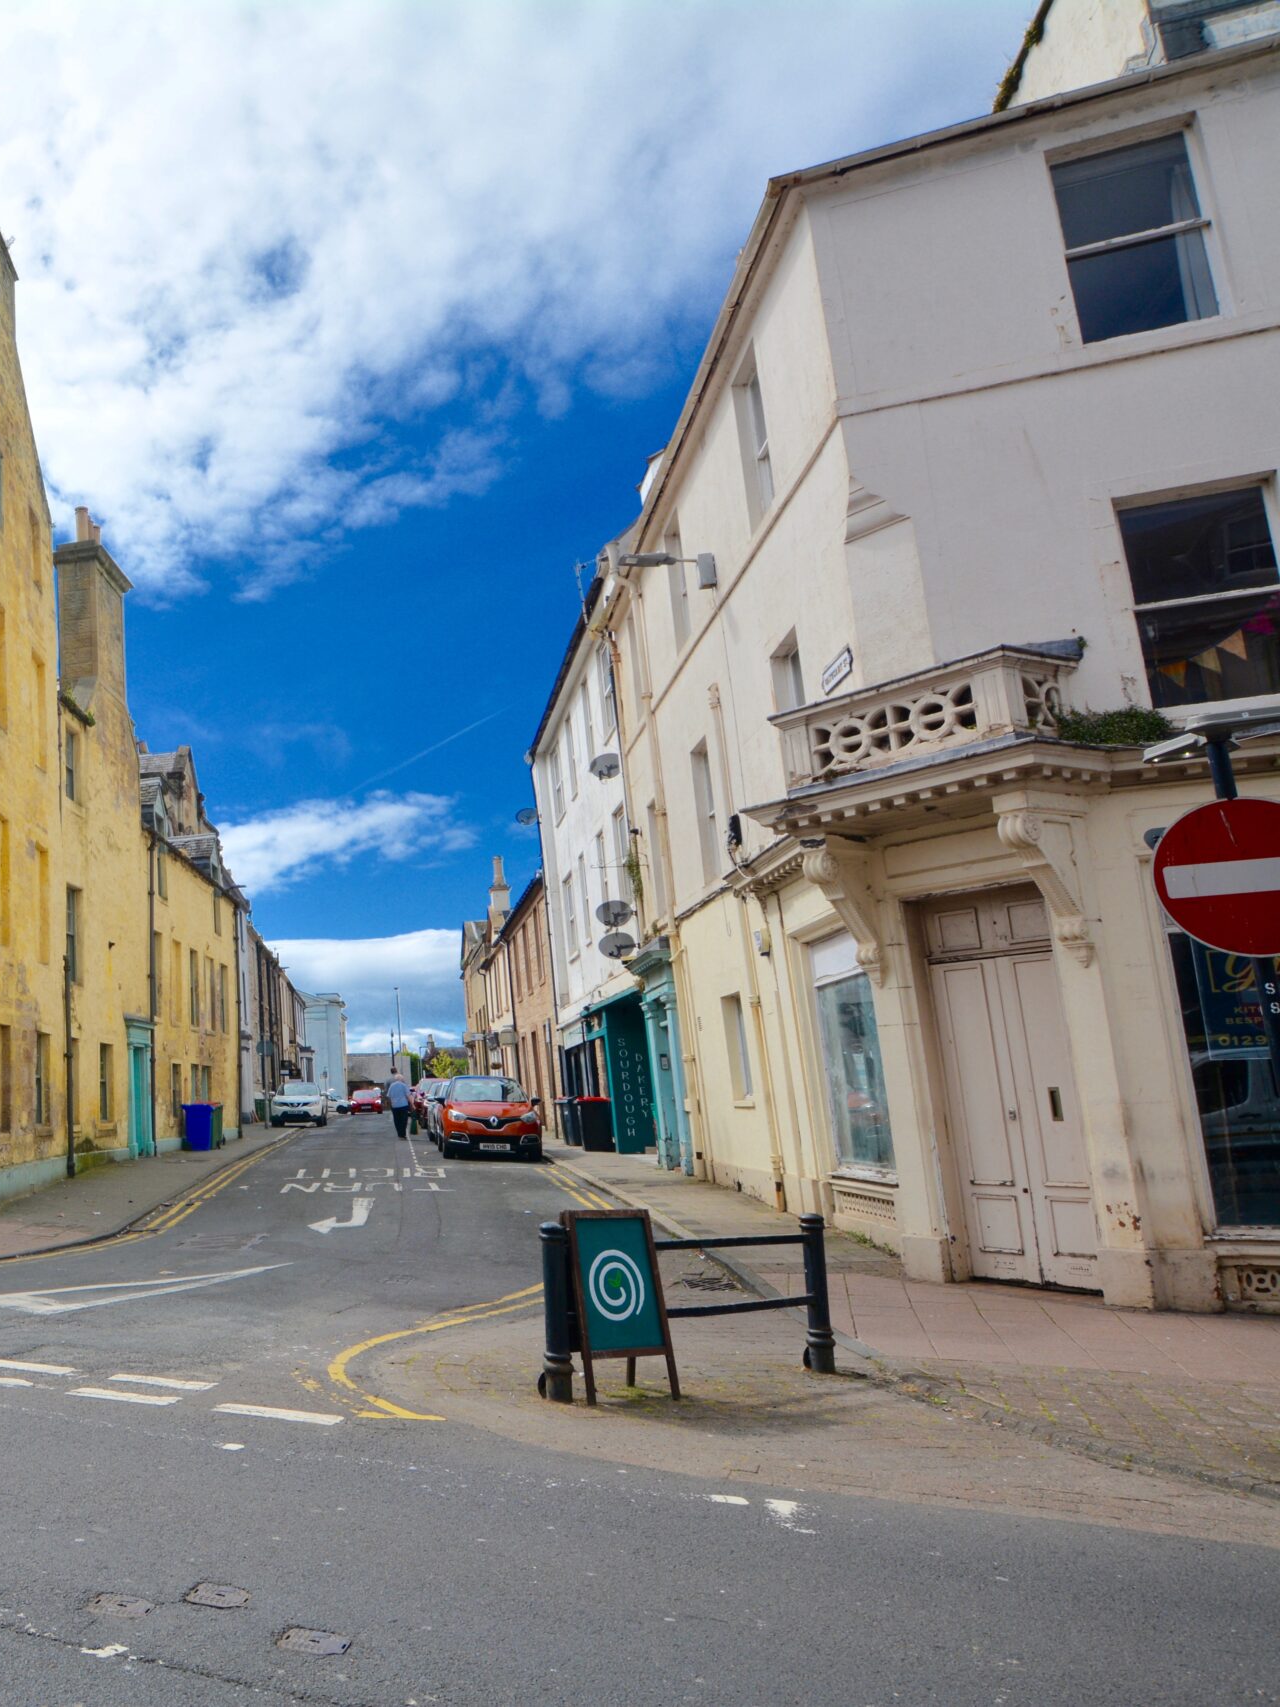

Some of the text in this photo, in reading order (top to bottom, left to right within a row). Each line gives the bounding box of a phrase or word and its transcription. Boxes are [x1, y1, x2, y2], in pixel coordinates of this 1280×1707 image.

[1218, 1034, 1268, 1047] 0129
[617, 1038, 636, 1137] SOURDOUGH
[283, 1167, 447, 1180] RIGHT
[280, 1182, 456, 1194] TURN
